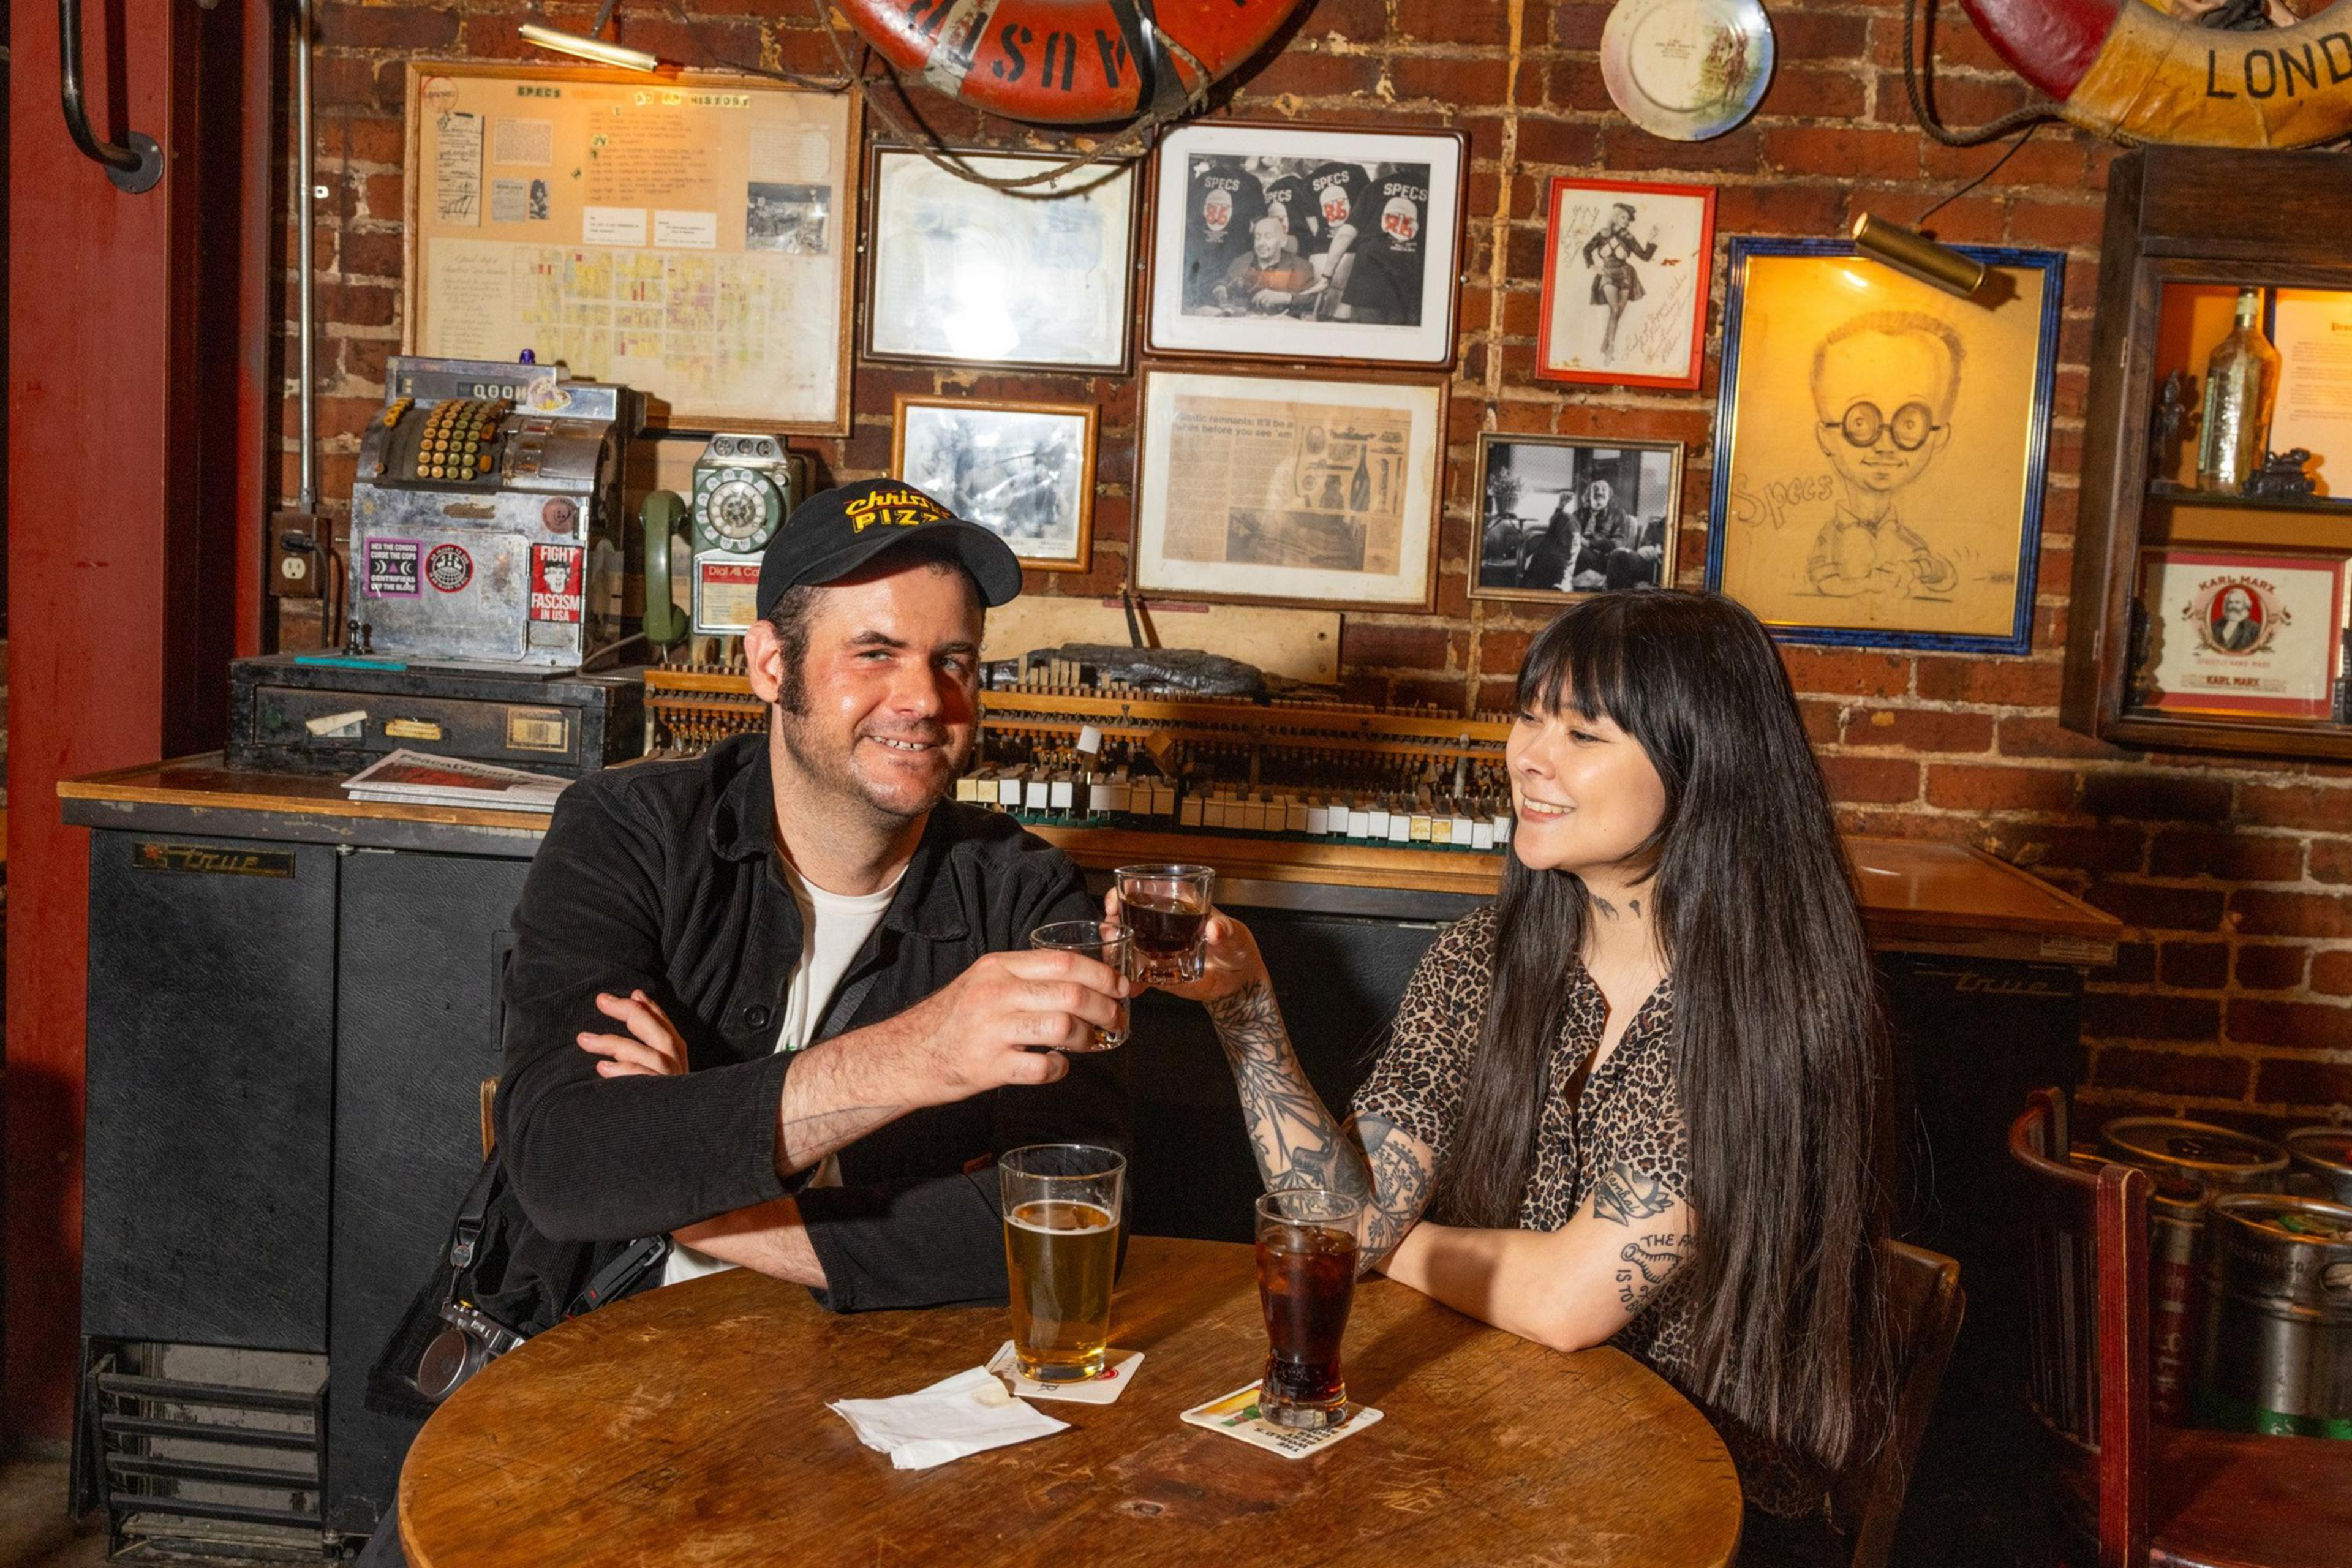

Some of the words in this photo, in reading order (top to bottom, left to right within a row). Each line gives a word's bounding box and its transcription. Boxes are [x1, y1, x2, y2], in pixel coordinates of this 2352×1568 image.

[517, 85, 562, 99] SPECS
[690, 94, 750, 107] HISTORY
[1205, 176, 1240, 192] SPECS
[1313, 171, 1350, 192] SPECS
[1264, 189, 1292, 204] SPECS
[1384, 183, 1428, 202] SPECS
[1202, 425, 1232, 434] before
[1235, 428, 1253, 437] you
[1732, 473, 1833, 529] Specs
[540, 545, 577, 562] FIGHT
[709, 566, 728, 576] Dial
[2198, 575, 2236, 591] KARL
[2240, 576, 2276, 594] MARX
[531, 592, 580, 611] FASCISM
[541, 609, 550, 620] IN
[552, 609, 570, 622] USA
[2207, 675, 2231, 685] KARL
[2234, 677, 2259, 687] MARX
[1640, 1234, 1675, 1248] THE
[1616, 1269, 1632, 1283] IS
[1619, 1284, 1634, 1302] TO
[1254, 1427, 1308, 1449] WORLD'S
[1276, 1442, 1300, 1452] THE
